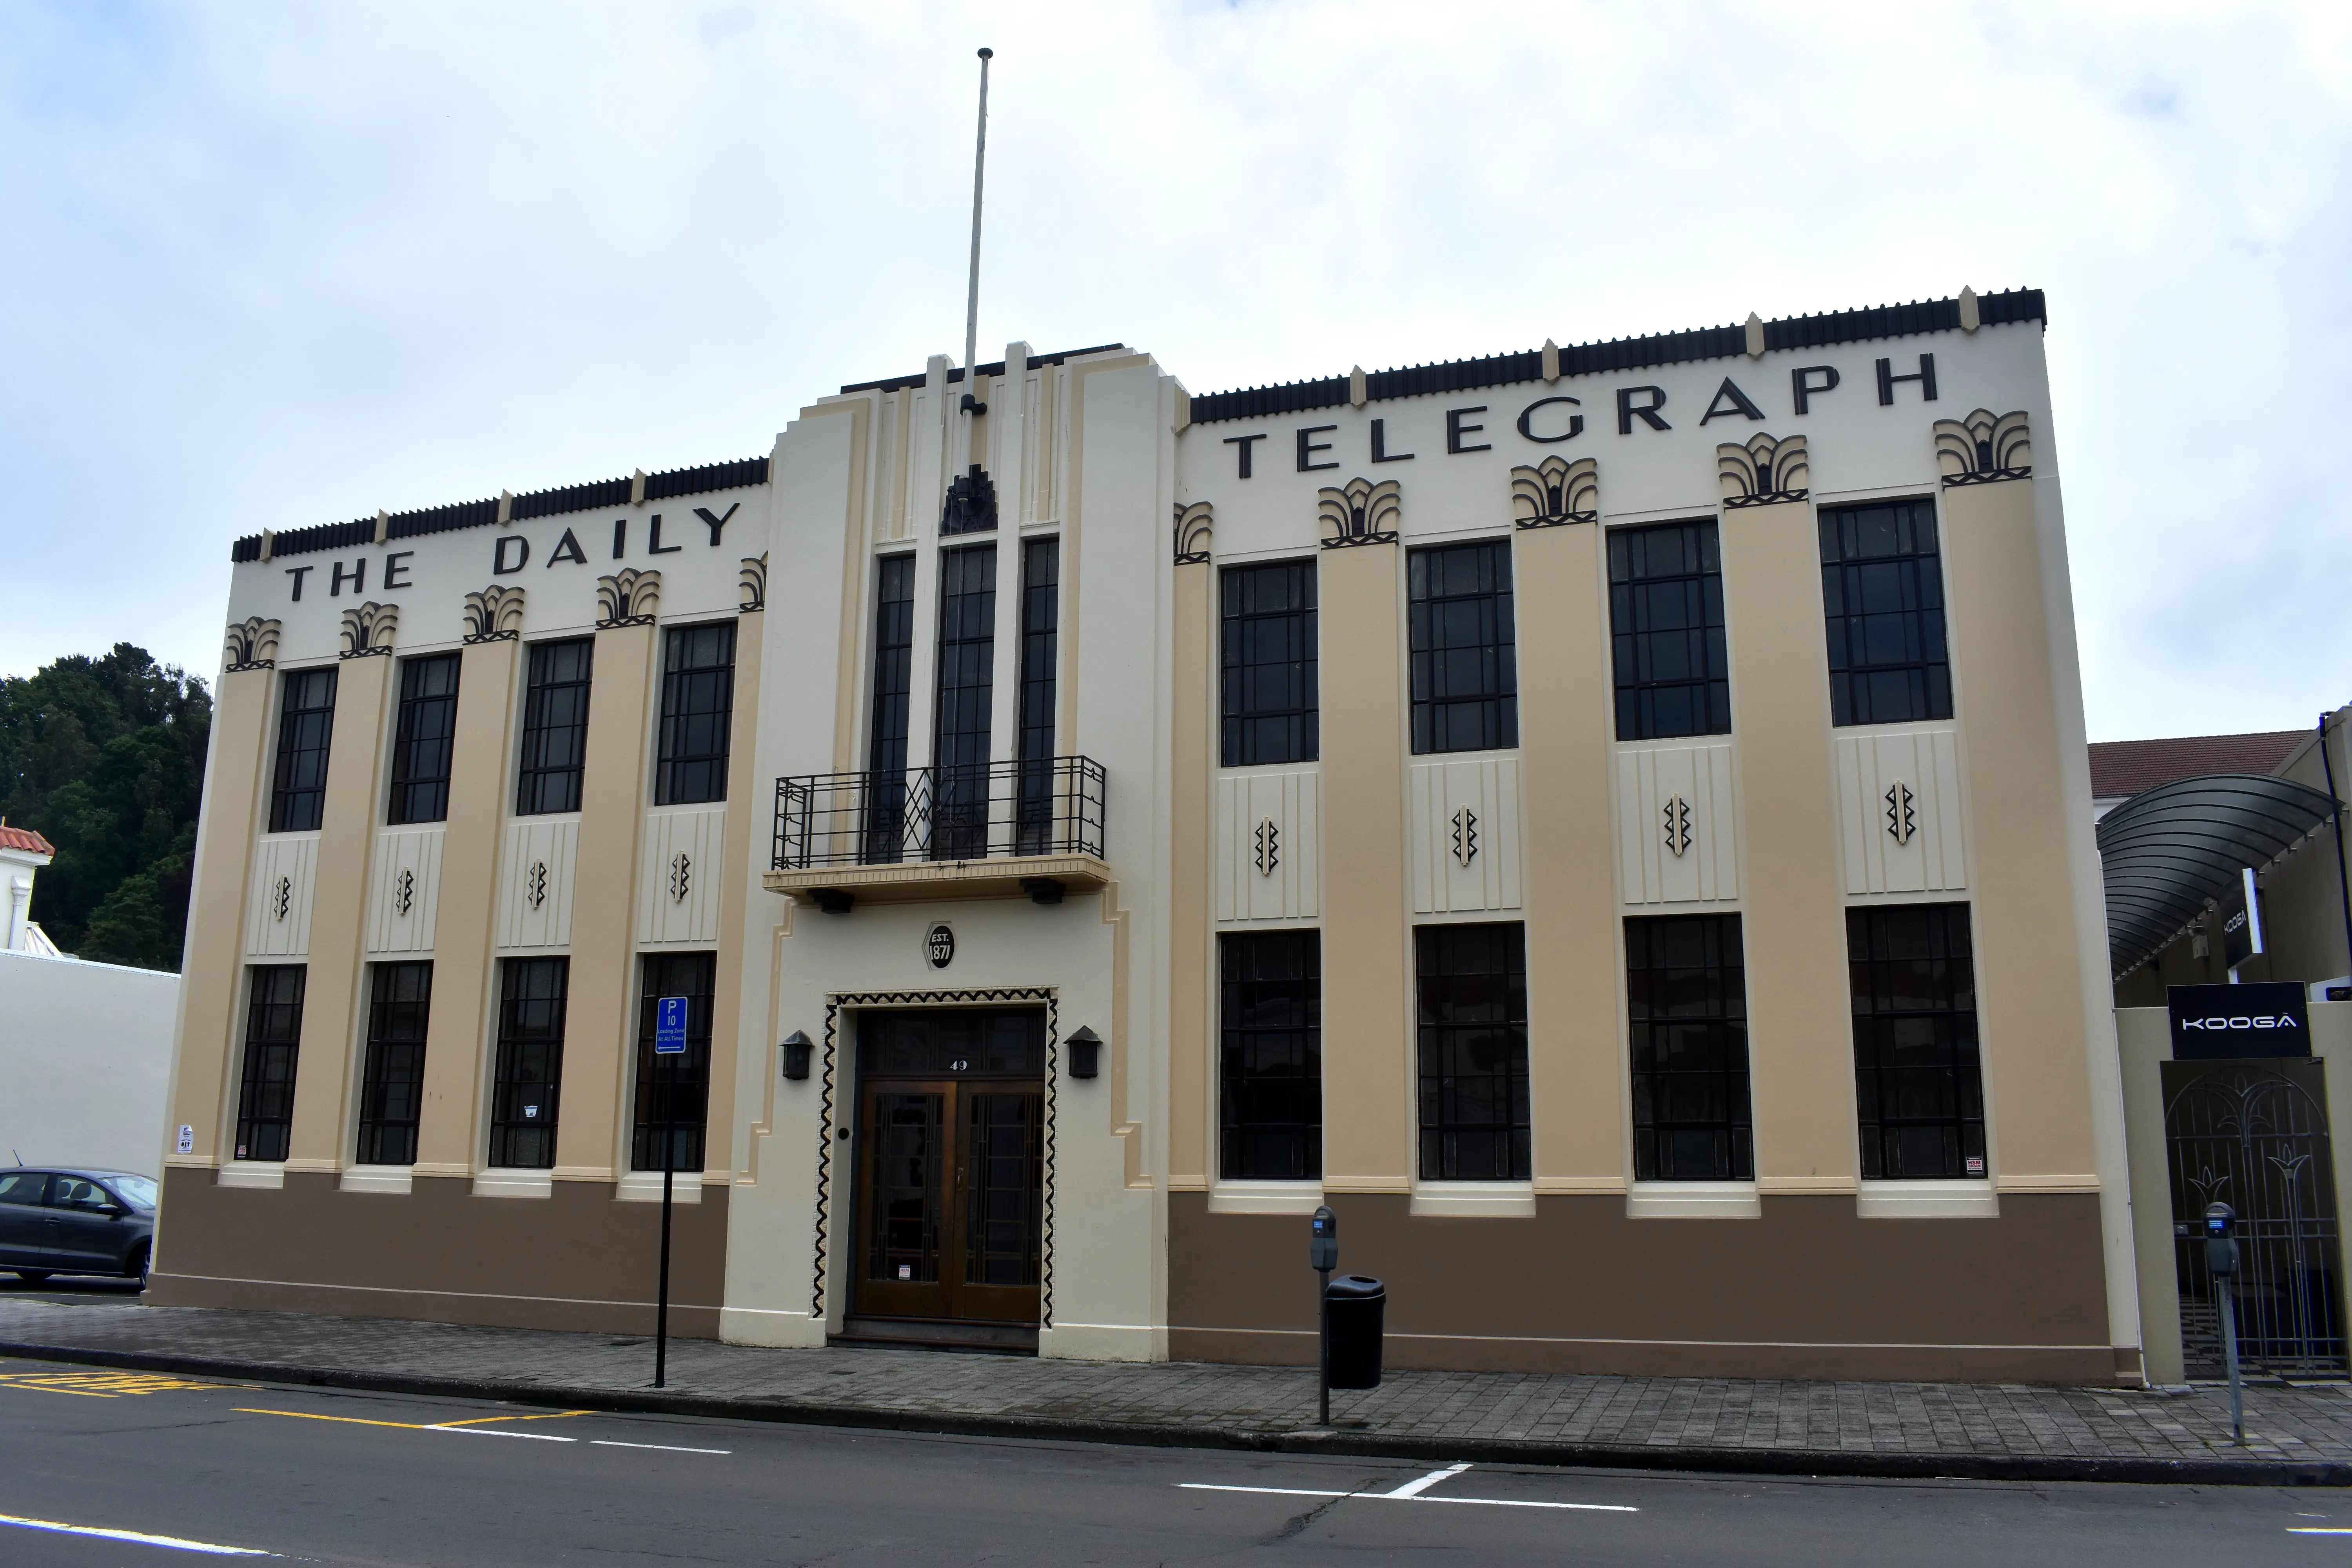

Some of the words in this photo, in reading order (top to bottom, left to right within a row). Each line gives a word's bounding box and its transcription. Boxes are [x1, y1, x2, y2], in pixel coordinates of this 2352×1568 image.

[285, 551, 414, 602] THE
[493, 503, 740, 575] DAILY
[1223, 352, 1938, 479] TELEGRAPH
[2223, 909, 2246, 936] KOOGA
[931, 933, 949, 942] EST.
[929, 945, 951, 960] 1871
[668, 1000, 677, 1014] P
[668, 1015, 676, 1026] 10
[2182, 1015, 2296, 1030] KOOGA
[950, 1060, 967, 1070] 49
